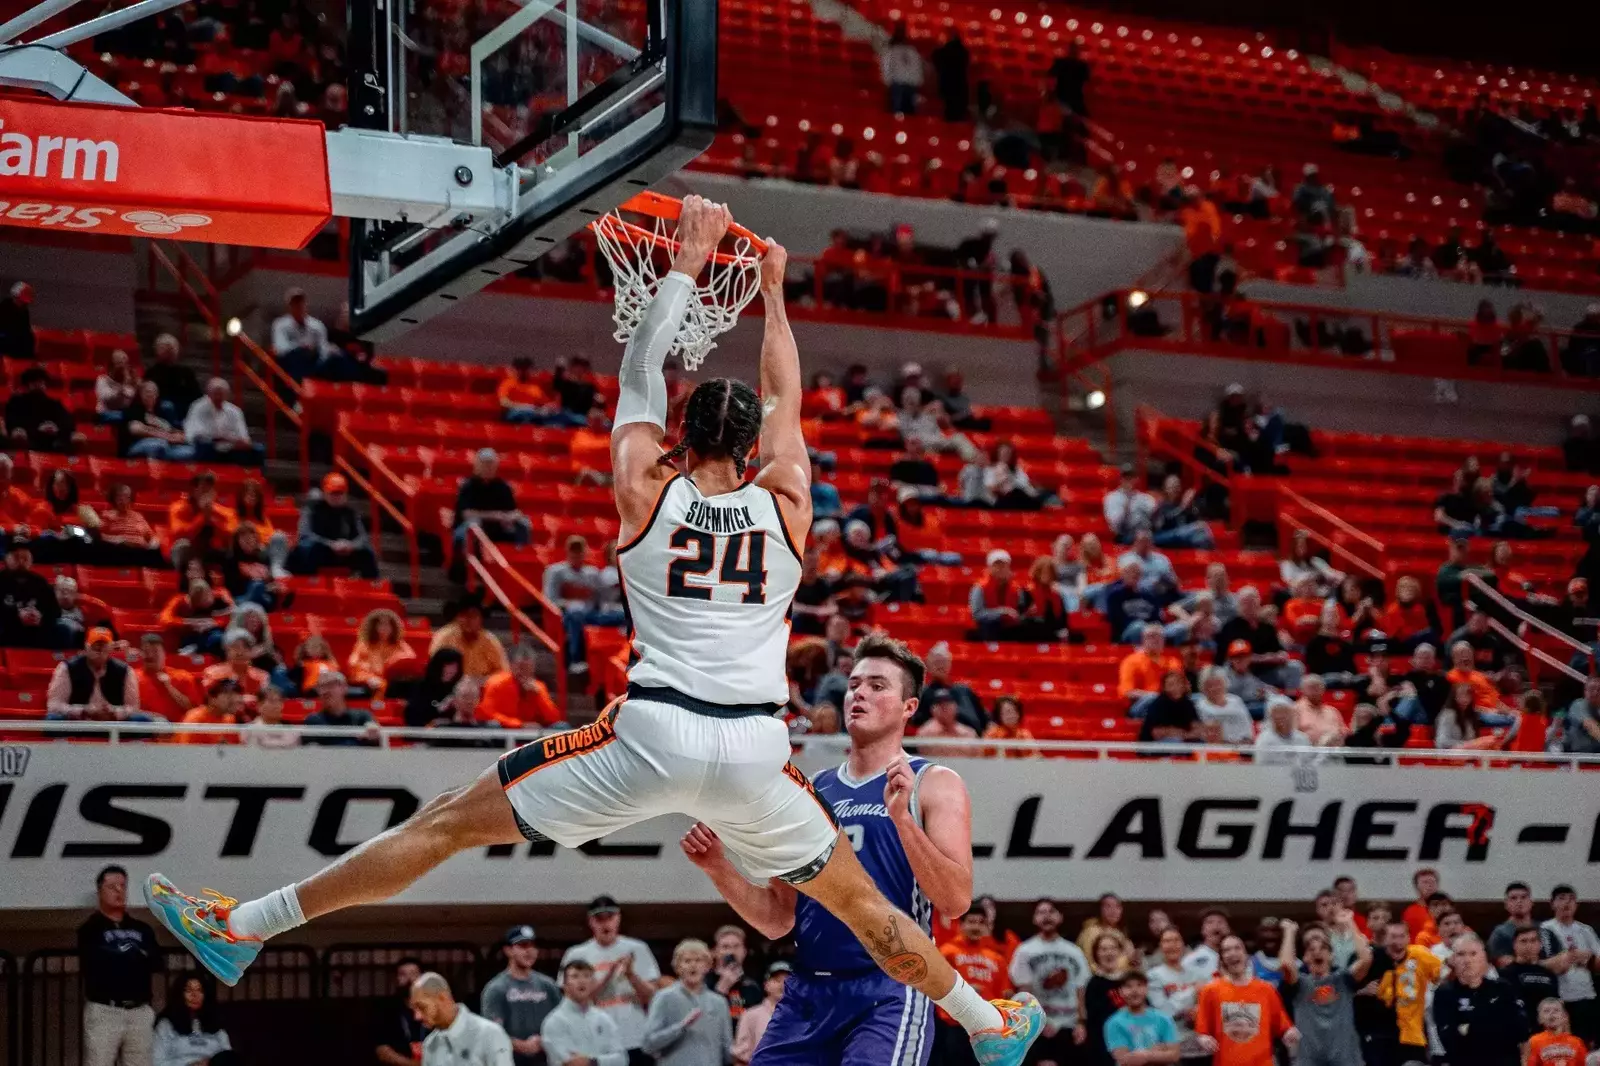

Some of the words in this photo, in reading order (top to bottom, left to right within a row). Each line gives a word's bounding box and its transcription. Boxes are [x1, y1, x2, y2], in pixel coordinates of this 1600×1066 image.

[0, 119, 119, 182] arm
[685, 501, 756, 533] SUEMNICK
[667, 525, 768, 605] 24
[0, 746, 31, 777] 07
[833, 798, 889, 818] Thomas
